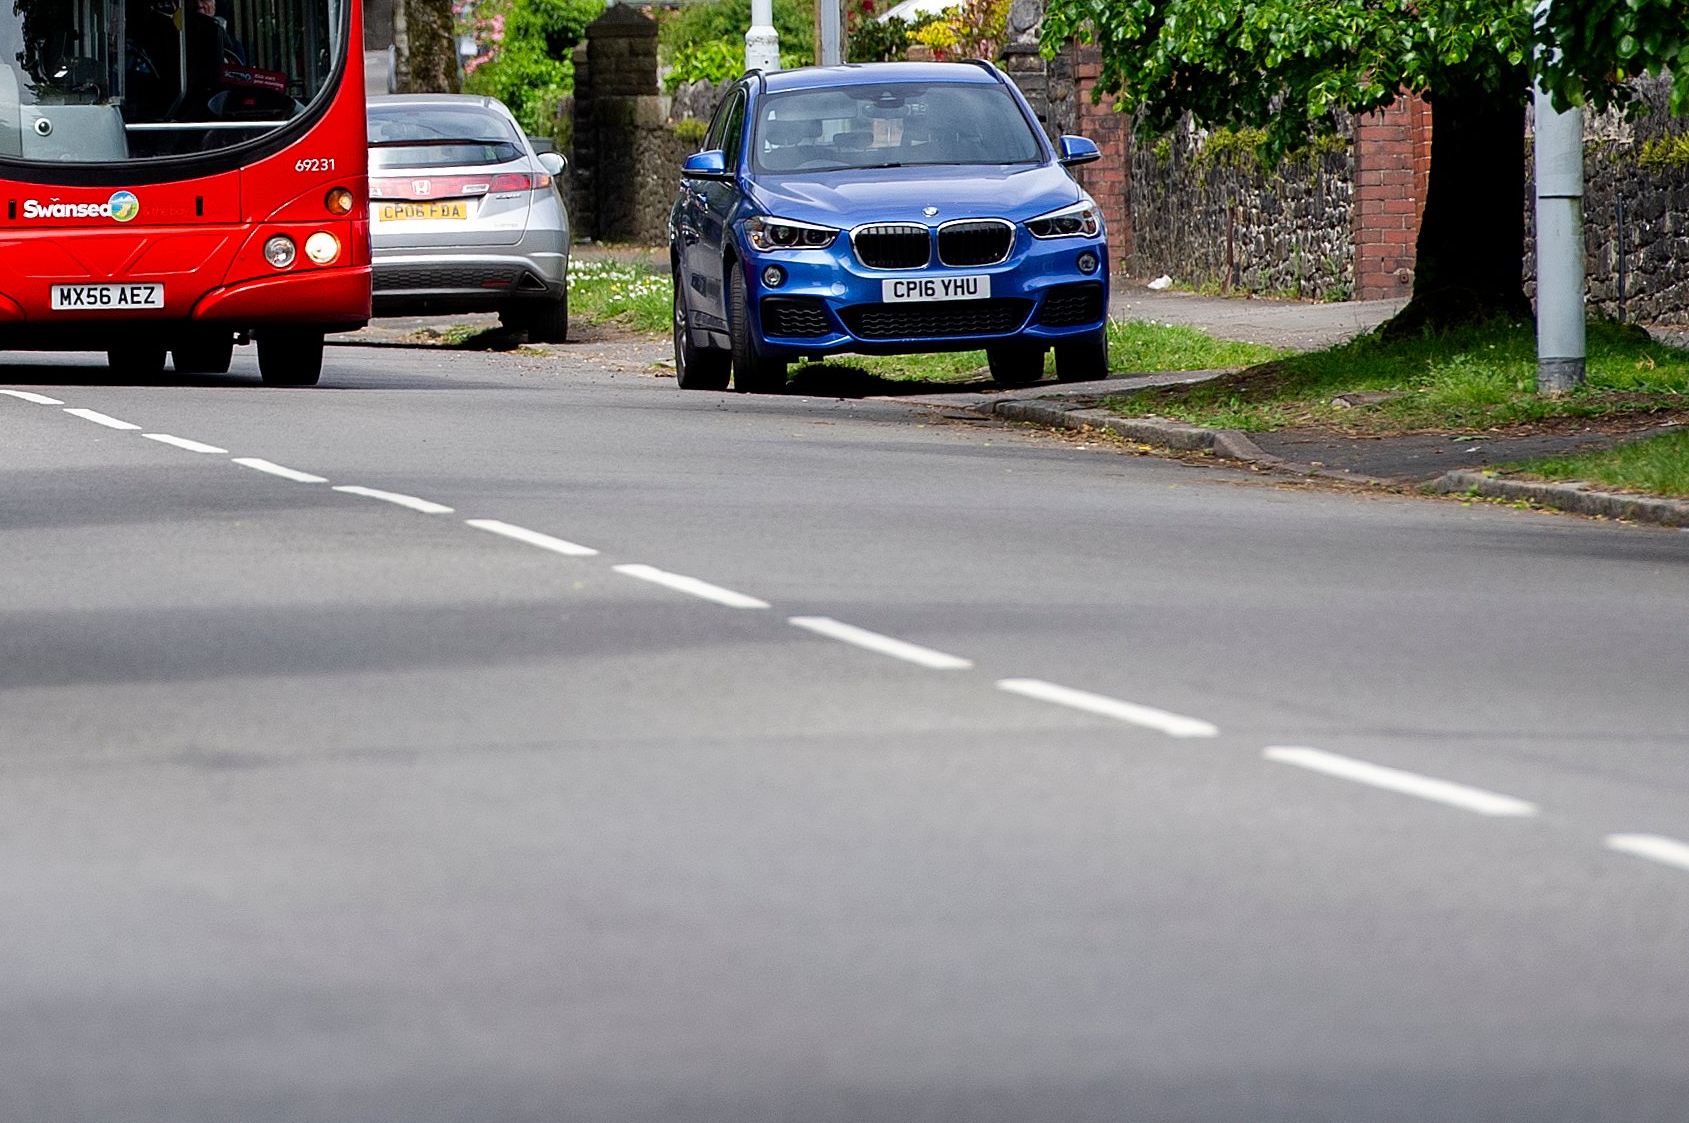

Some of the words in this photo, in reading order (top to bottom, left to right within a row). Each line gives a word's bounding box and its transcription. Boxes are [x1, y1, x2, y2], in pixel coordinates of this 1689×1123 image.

[294, 158, 335, 172] 69231
[23, 199, 113, 218] Swansea
[384, 202, 425, 220] CP06
[59, 287, 111, 306] MX56
[117, 286, 156, 305] AEZ
[893, 280, 936, 298] CP16
[940, 277, 978, 296] YHU
